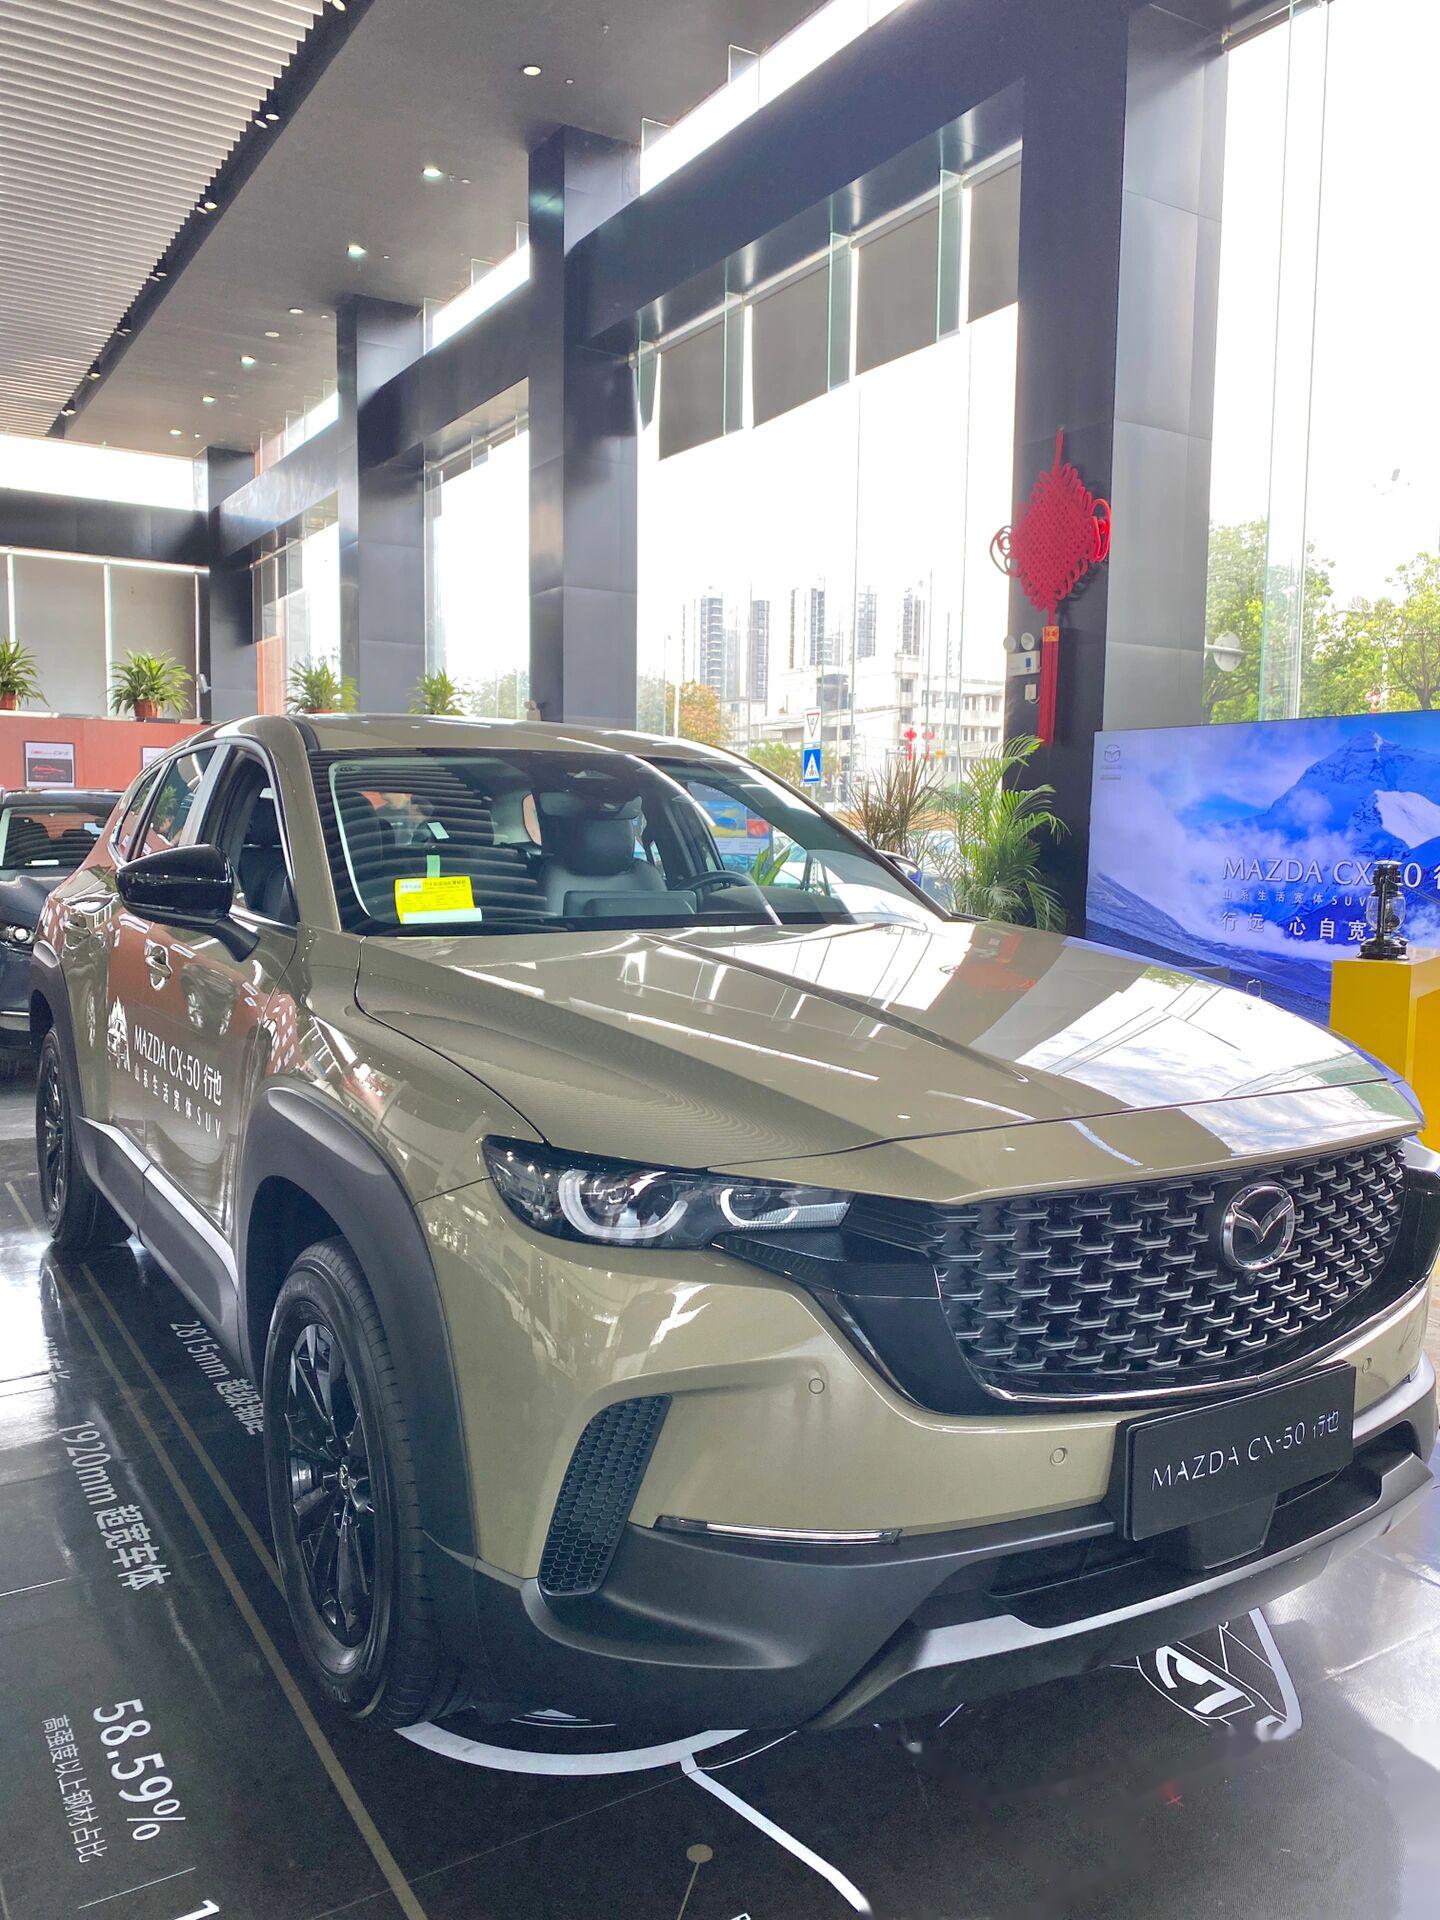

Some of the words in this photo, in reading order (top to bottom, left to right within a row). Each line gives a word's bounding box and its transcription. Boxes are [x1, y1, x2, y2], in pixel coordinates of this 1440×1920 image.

[1222, 857, 1322, 884] MAZDA
[1333, 861, 1422, 888] CX0
[133, 1025, 166, 1070] MAZDA
[169, 1045, 200, 1091] CX-50
[169, 1320, 231, 1379] 2815mm
[1151, 1446, 1239, 1491] MAZDA
[58, 1420, 118, 1505] 1920mm
[93, 1503, 171, 1591] 超宽车体
[41, 1714, 108, 1863] 高强度以上钢材占比
[93, 1698, 186, 1841] 58.59%
